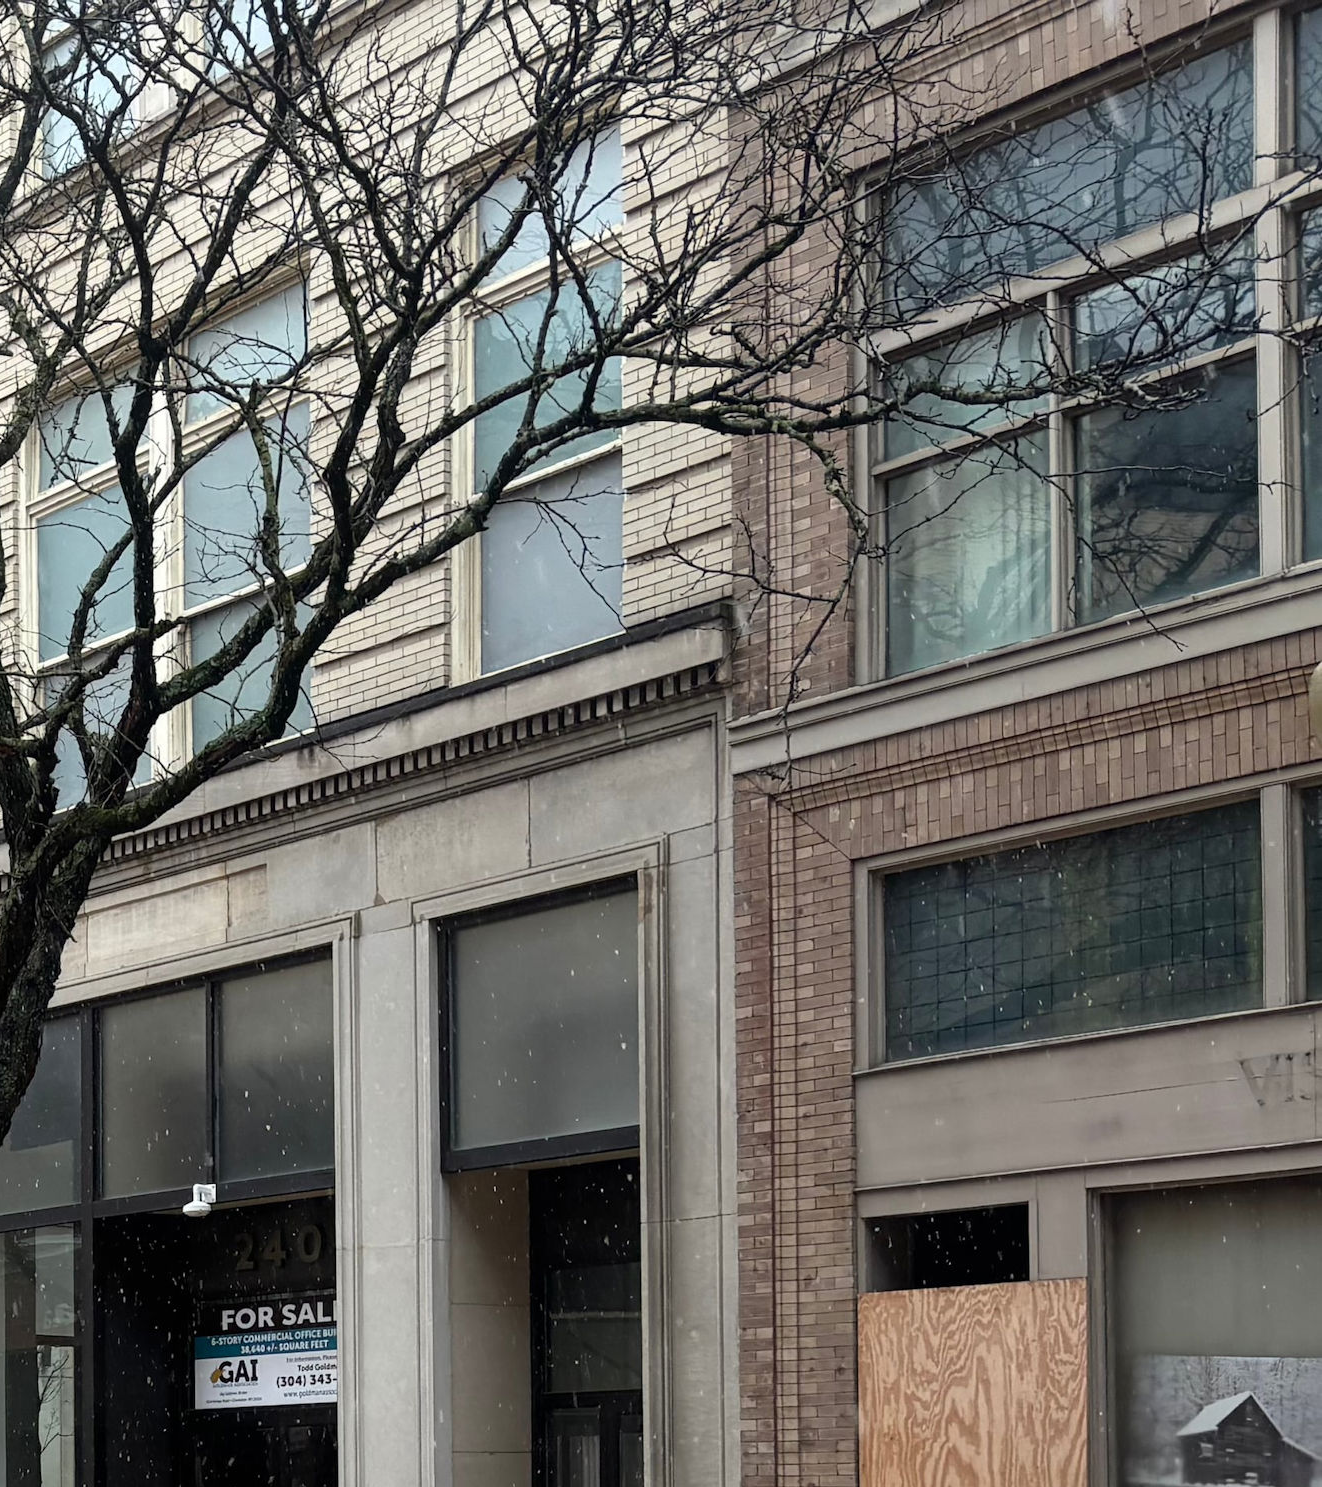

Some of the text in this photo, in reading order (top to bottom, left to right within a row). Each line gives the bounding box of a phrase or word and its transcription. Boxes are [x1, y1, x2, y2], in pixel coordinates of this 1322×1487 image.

[234, 1224, 324, 1271] 240
[221, 1305, 275, 1331] FOR
[211, 1334, 242, 1346] 6-STORY
[243, 1330, 293, 1344] COMMERCIAL
[295, 1328, 322, 1340] OFFICE
[279, 1341, 309, 1352] SQUARE
[310, 1339, 329, 1349] FEET
[219, 1359, 259, 1384] GAI
[297, 1364, 314, 1372] Todd
[276, 1373, 338, 1389] (304) 343-
